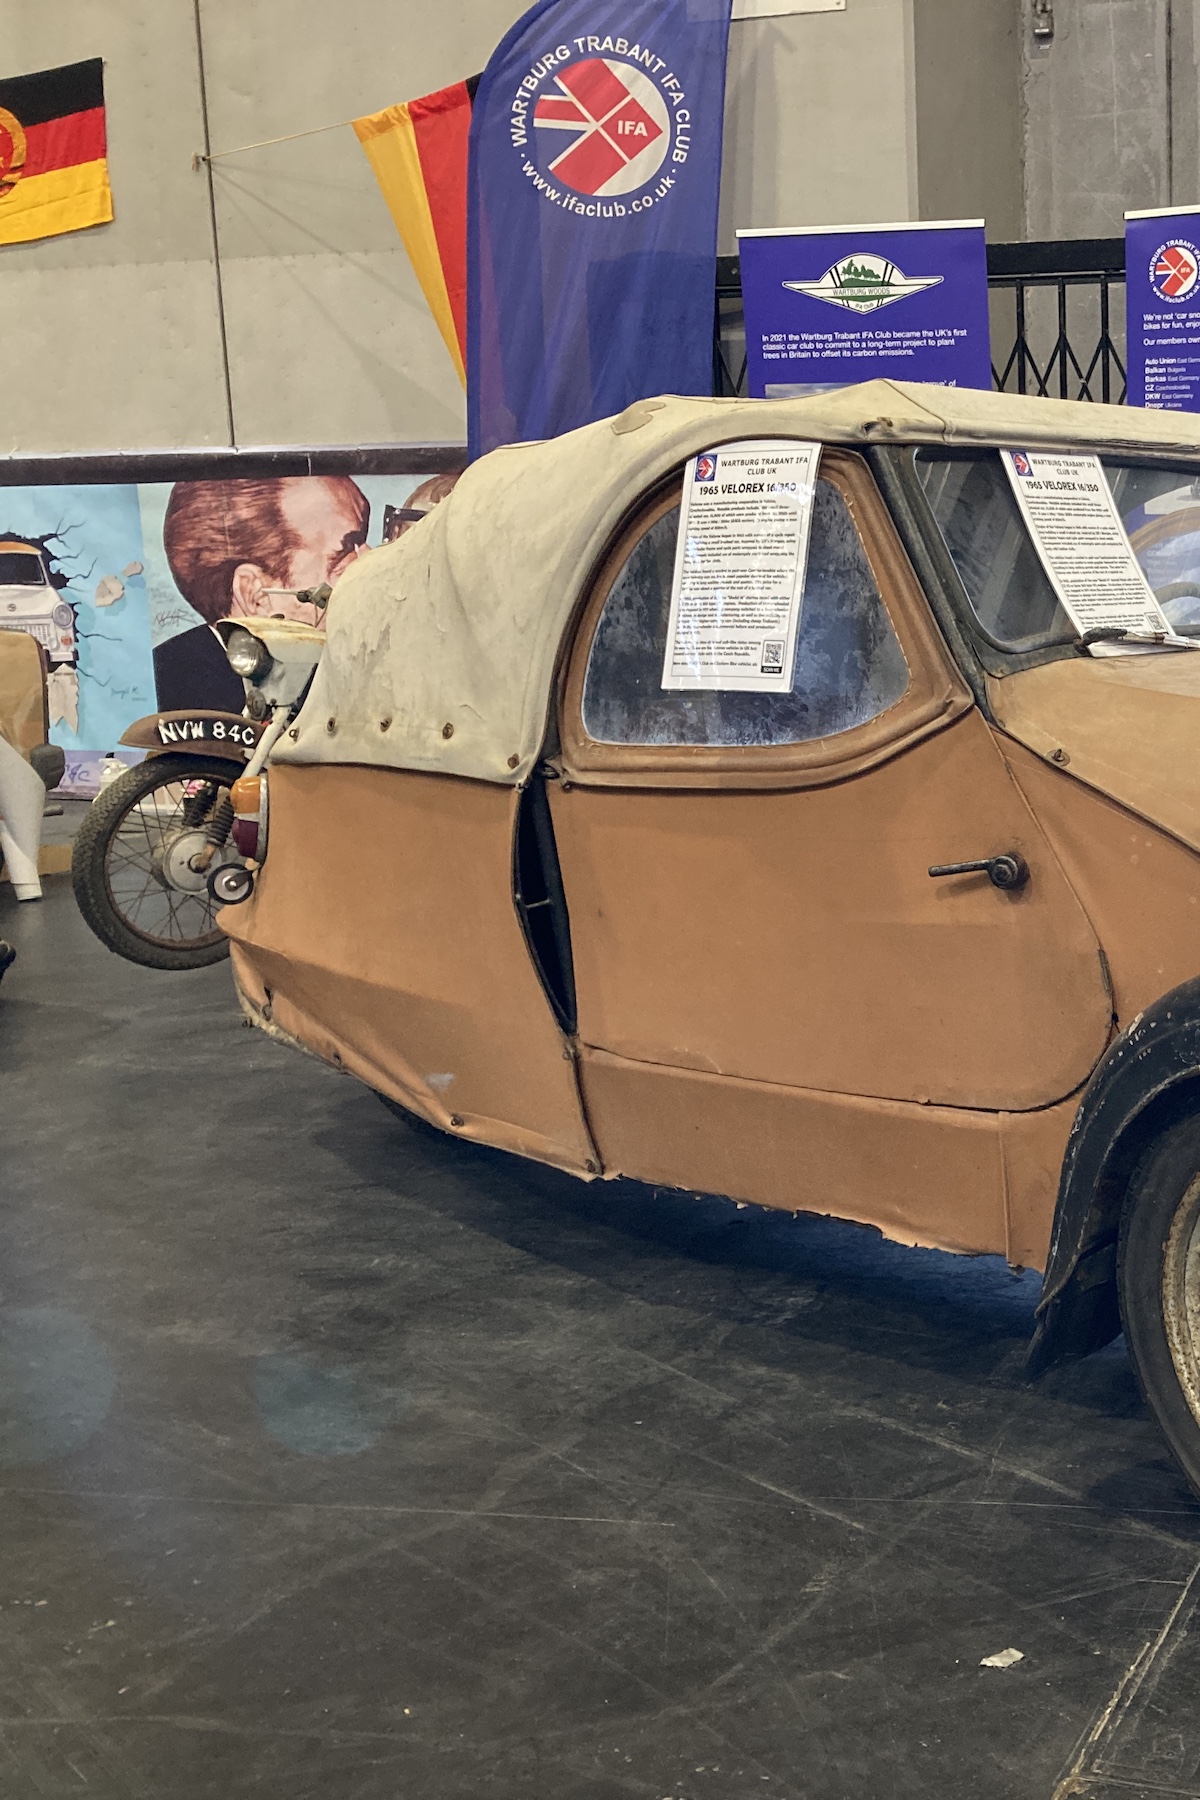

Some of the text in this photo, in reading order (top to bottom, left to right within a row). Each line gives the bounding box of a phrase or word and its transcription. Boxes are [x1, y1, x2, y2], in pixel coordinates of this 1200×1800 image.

[510, 36, 691, 163] WARTBURG TRABANT IFA CLUB
[617, 120, 648, 136] IFA
[521, 161, 676, 217] www.ifaclub.co.uk
[1149, 245, 1166, 283] WARTBURG
[1166, 239, 1195, 250] TRABANT
[833, 287, 890, 296] WARTBURG WOODS
[1163, 312, 1174, 320] not
[1143, 322, 1161, 330] bikes
[1162, 321, 1171, 329] for
[762, 334, 769, 342] In
[770, 334, 786, 342] 2021
[787, 333, 800, 341] the
[800, 332, 833, 342] Wartburg
[834, 331, 860, 340] Trabant
[862, 331, 874, 339] IFA
[875, 330, 891, 338] Club
[893, 330, 921, 338] became
[953, 328, 967, 336] first
[1143, 338, 1156, 346] Our
[1156, 336, 1187, 345] members
[763, 343, 786, 351] classic
[902, 339, 927, 348] project
[937, 338, 955, 347] plant
[763, 351, 780, 359] trees
[789, 350, 811, 358] Britain
[812, 350, 820, 358] to
[842, 349, 851, 357] its
[852, 349, 877, 357] carbon
[721, 456, 808, 467] WARTBURG TRABANT IFA
[1032, 459, 1062, 467] WARTBURG
[1062, 460, 1086, 468] TRABANT
[700, 486, 719, 495] 1965
[721, 483, 765, 494] VELOREX
[1026, 480, 1099, 492] 1965 VELOREX 16/350
[158, 720, 255, 745] NVW 84C
